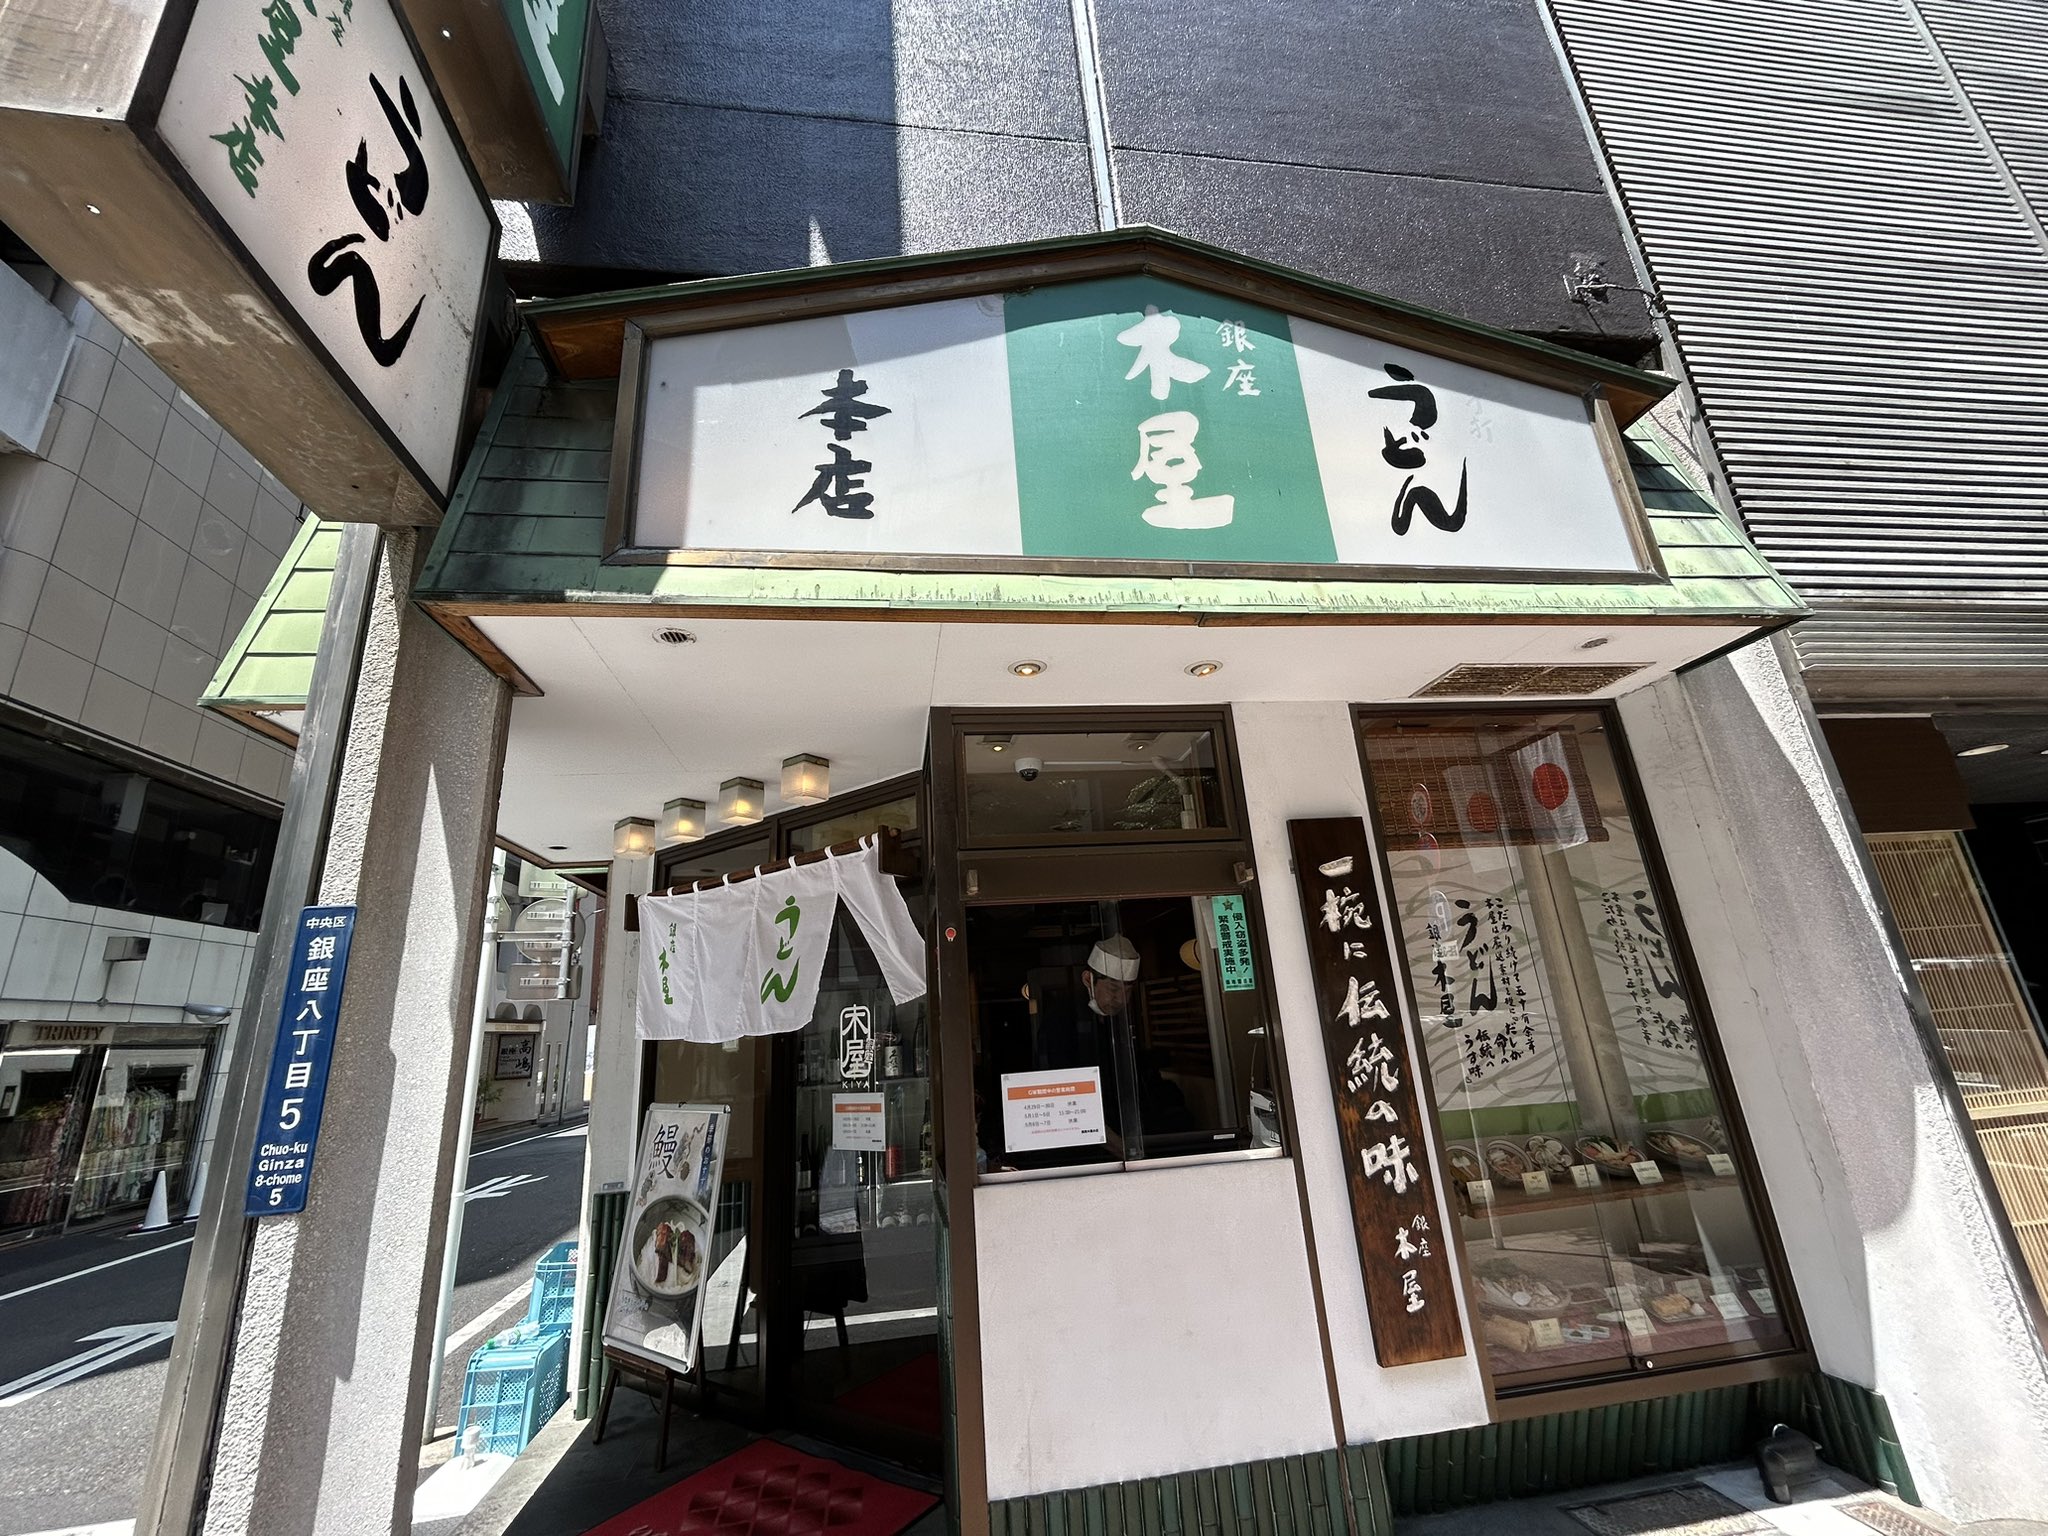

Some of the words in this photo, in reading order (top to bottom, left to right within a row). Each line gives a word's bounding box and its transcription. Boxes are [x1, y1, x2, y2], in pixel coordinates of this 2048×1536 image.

[209, 0, 318, 199] 屋本店
[308, 72, 429, 368] うどん
[1216, 320, 1261, 396] 銀座
[791, 368, 893, 520] 本店
[1117, 304, 1235, 529] 木屋
[1367, 362, 1469, 536] うどん
[306, 915, 347, 929] 中央区
[760, 895, 800, 1005] うどん
[1218, 915, 1236, 974] 緊急警戒実施中
[658, 946, 673, 1005] 木屋
[1454, 899, 1498, 1016] うどん
[35, 1024, 104, 1040] TRINITY
[841, 1004, 870, 1079] 木屋
[1318, 856, 1421, 1194] 一椀に伝統の味
[1475, 1028, 1496, 1068] 伝統の
[1494, 1032, 1509, 1064] 命の
[1505, 1021, 1524, 1061] だしが
[841, 1080, 871, 1089] KIYA
[258, 1157, 305, 1172] Ginza
[260, 1141, 309, 1157] Chuo-ku
[650, 1123, 680, 1180] 鰻
[255, 1173, 302, 1187] 8-chome
[268, 1187, 282, 1207] 5
[1411, 1214, 1433, 1258] 銀座
[1394, 1227, 1426, 1314] 木屋
